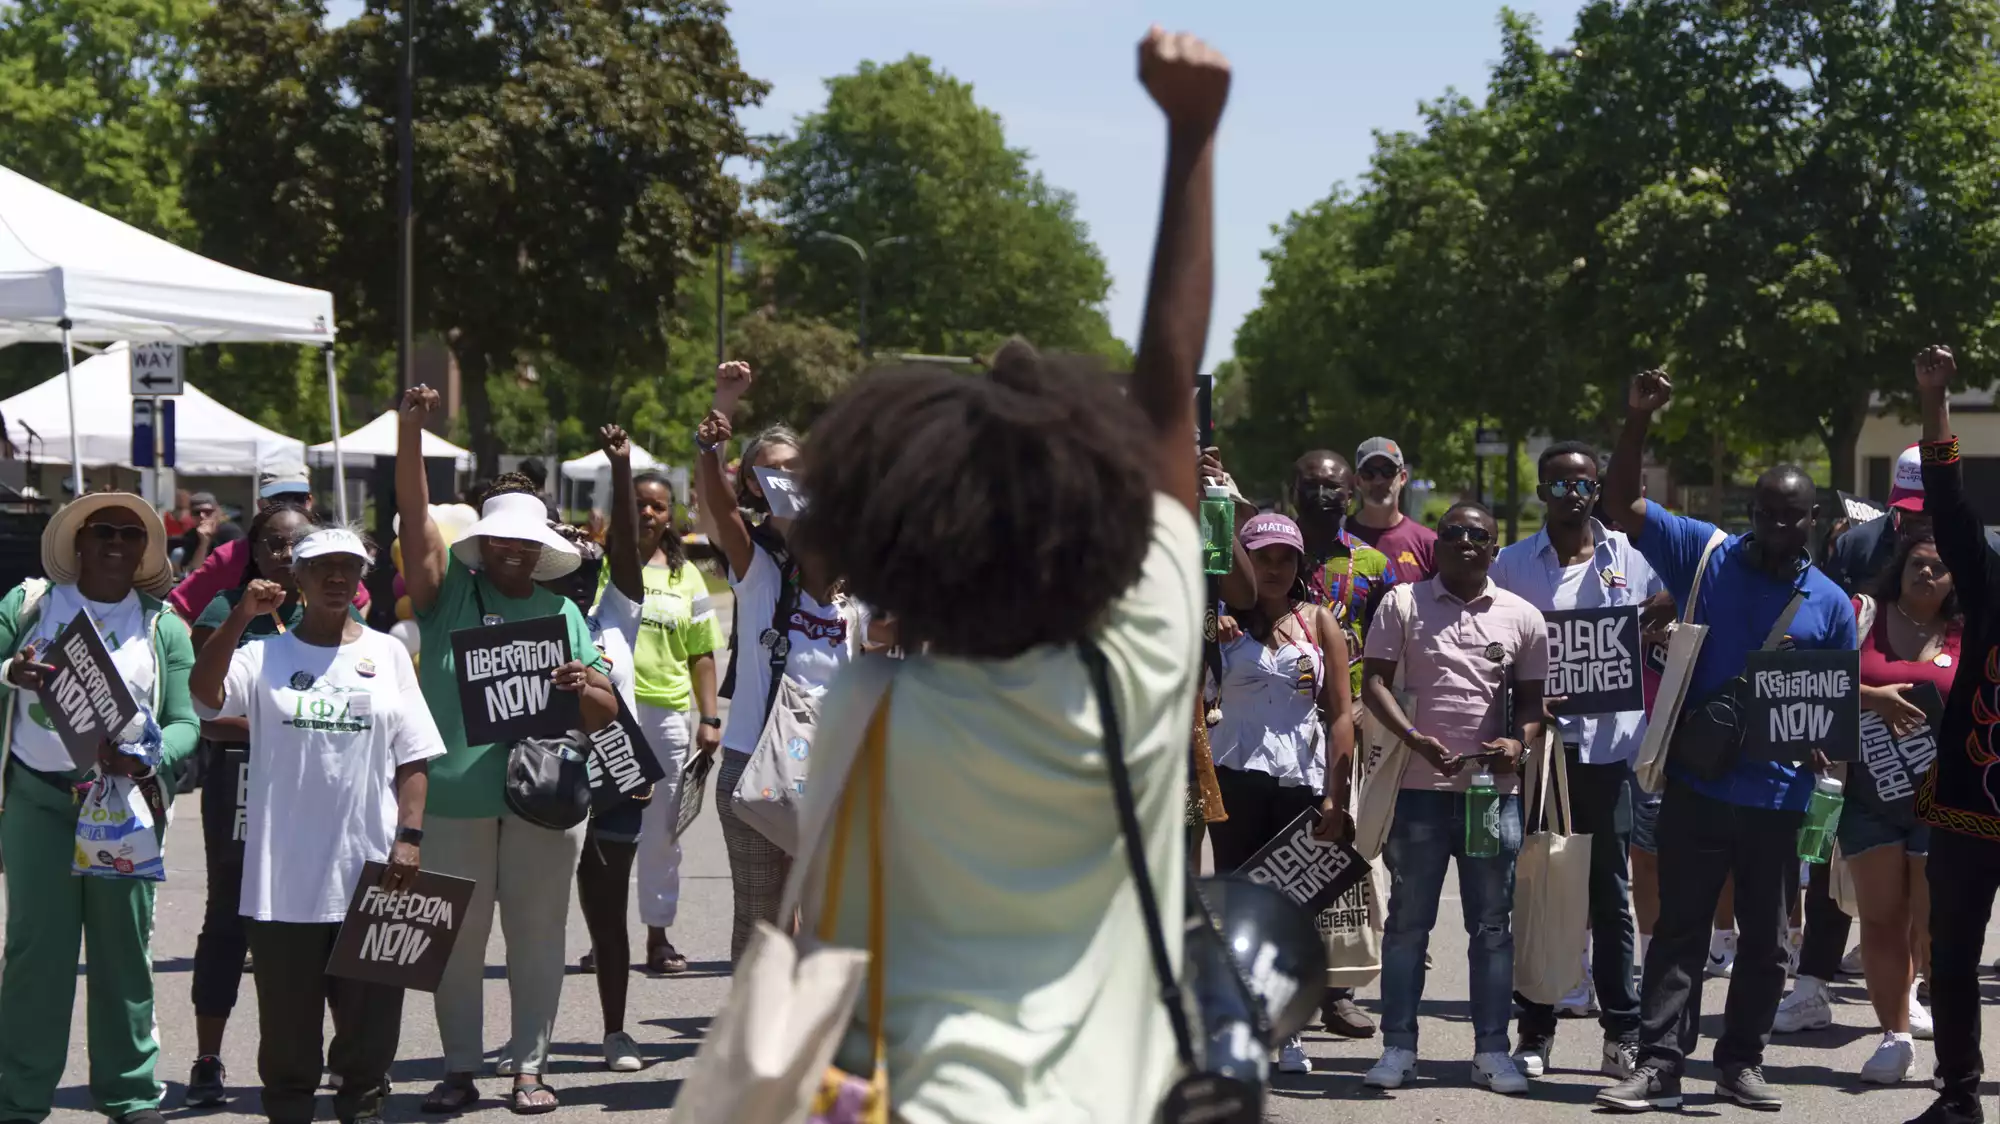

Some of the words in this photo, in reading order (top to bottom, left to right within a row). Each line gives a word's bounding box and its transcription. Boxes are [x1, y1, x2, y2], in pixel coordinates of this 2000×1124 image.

[133, 351, 173, 368] WAY
[1547, 616, 1632, 662] BLACK
[50, 666, 96, 734] NOW
[484, 675, 552, 723] NOW
[1544, 658, 1633, 696] FUTURES
[1770, 702, 1834, 743] NOW
[589, 720, 647, 794] OLITION
[1247, 820, 1336, 890] BLACK
[1283, 844, 1352, 906] TURES
[358, 885, 453, 930] FREEDOM
[358, 922, 432, 966] NOW
